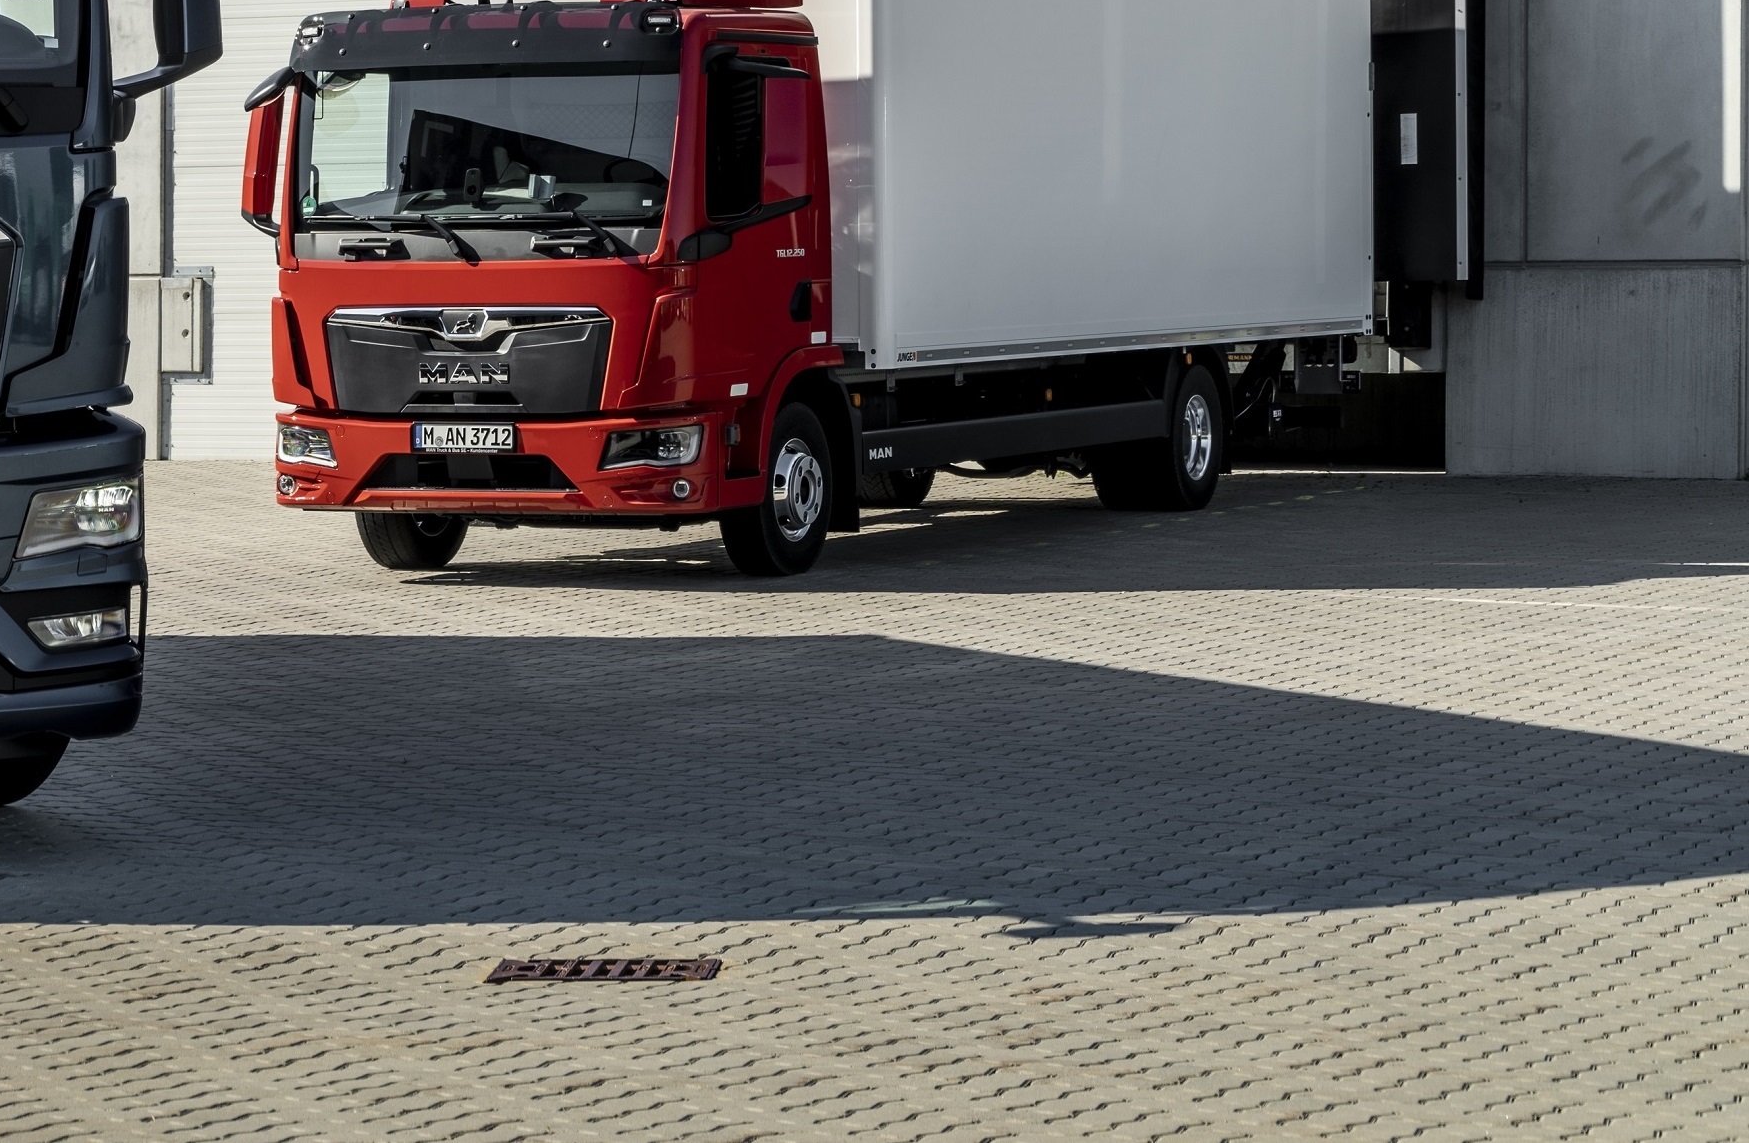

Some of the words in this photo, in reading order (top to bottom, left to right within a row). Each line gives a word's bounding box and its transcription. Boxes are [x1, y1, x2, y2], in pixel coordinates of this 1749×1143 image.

[419, 362, 509, 384] MAN
[423, 427, 434, 446] M
[445, 427, 467, 446] AN
[470, 427, 512, 447] 3712
[869, 446, 893, 460] MAN
